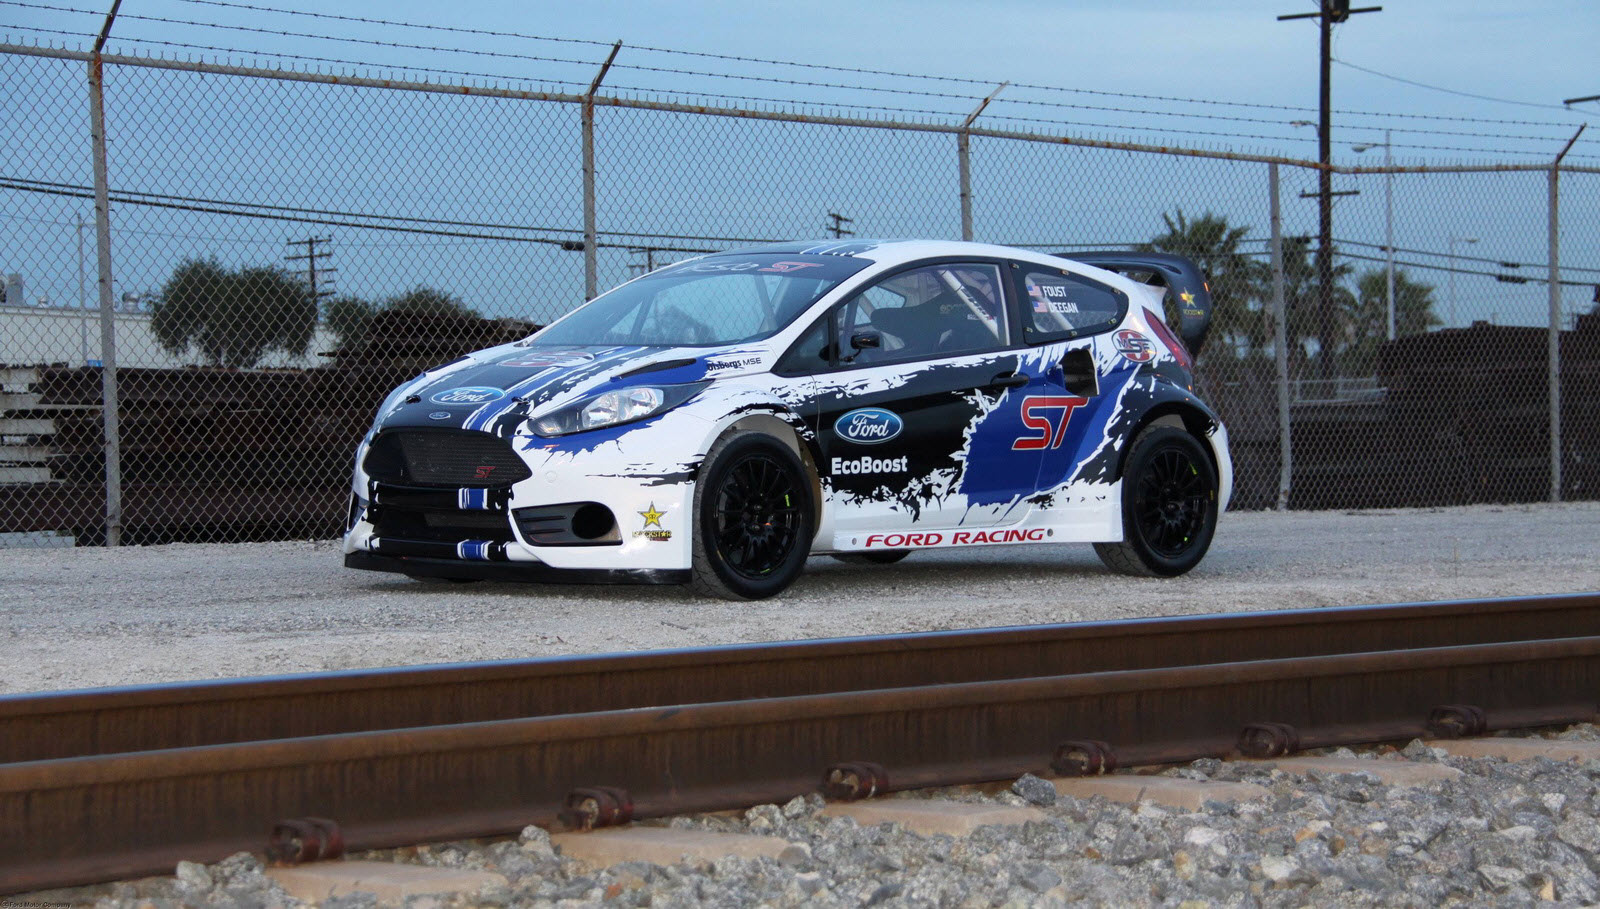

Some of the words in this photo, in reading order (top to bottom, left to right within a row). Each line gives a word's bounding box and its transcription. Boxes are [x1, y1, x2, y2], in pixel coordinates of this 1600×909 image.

[1042, 285, 1067, 297] FOUST
[1048, 302, 1079, 314] DEEGAN
[742, 357, 762, 367] MSE
[440, 388, 494, 402] Ford
[848, 413, 890, 438] Ford
[1011, 394, 1090, 451] ST
[474, 466, 497, 479] ST
[831, 455, 908, 476] EcoBoost
[865, 533, 943, 548] FORD
[952, 528, 1045, 545] RACING
